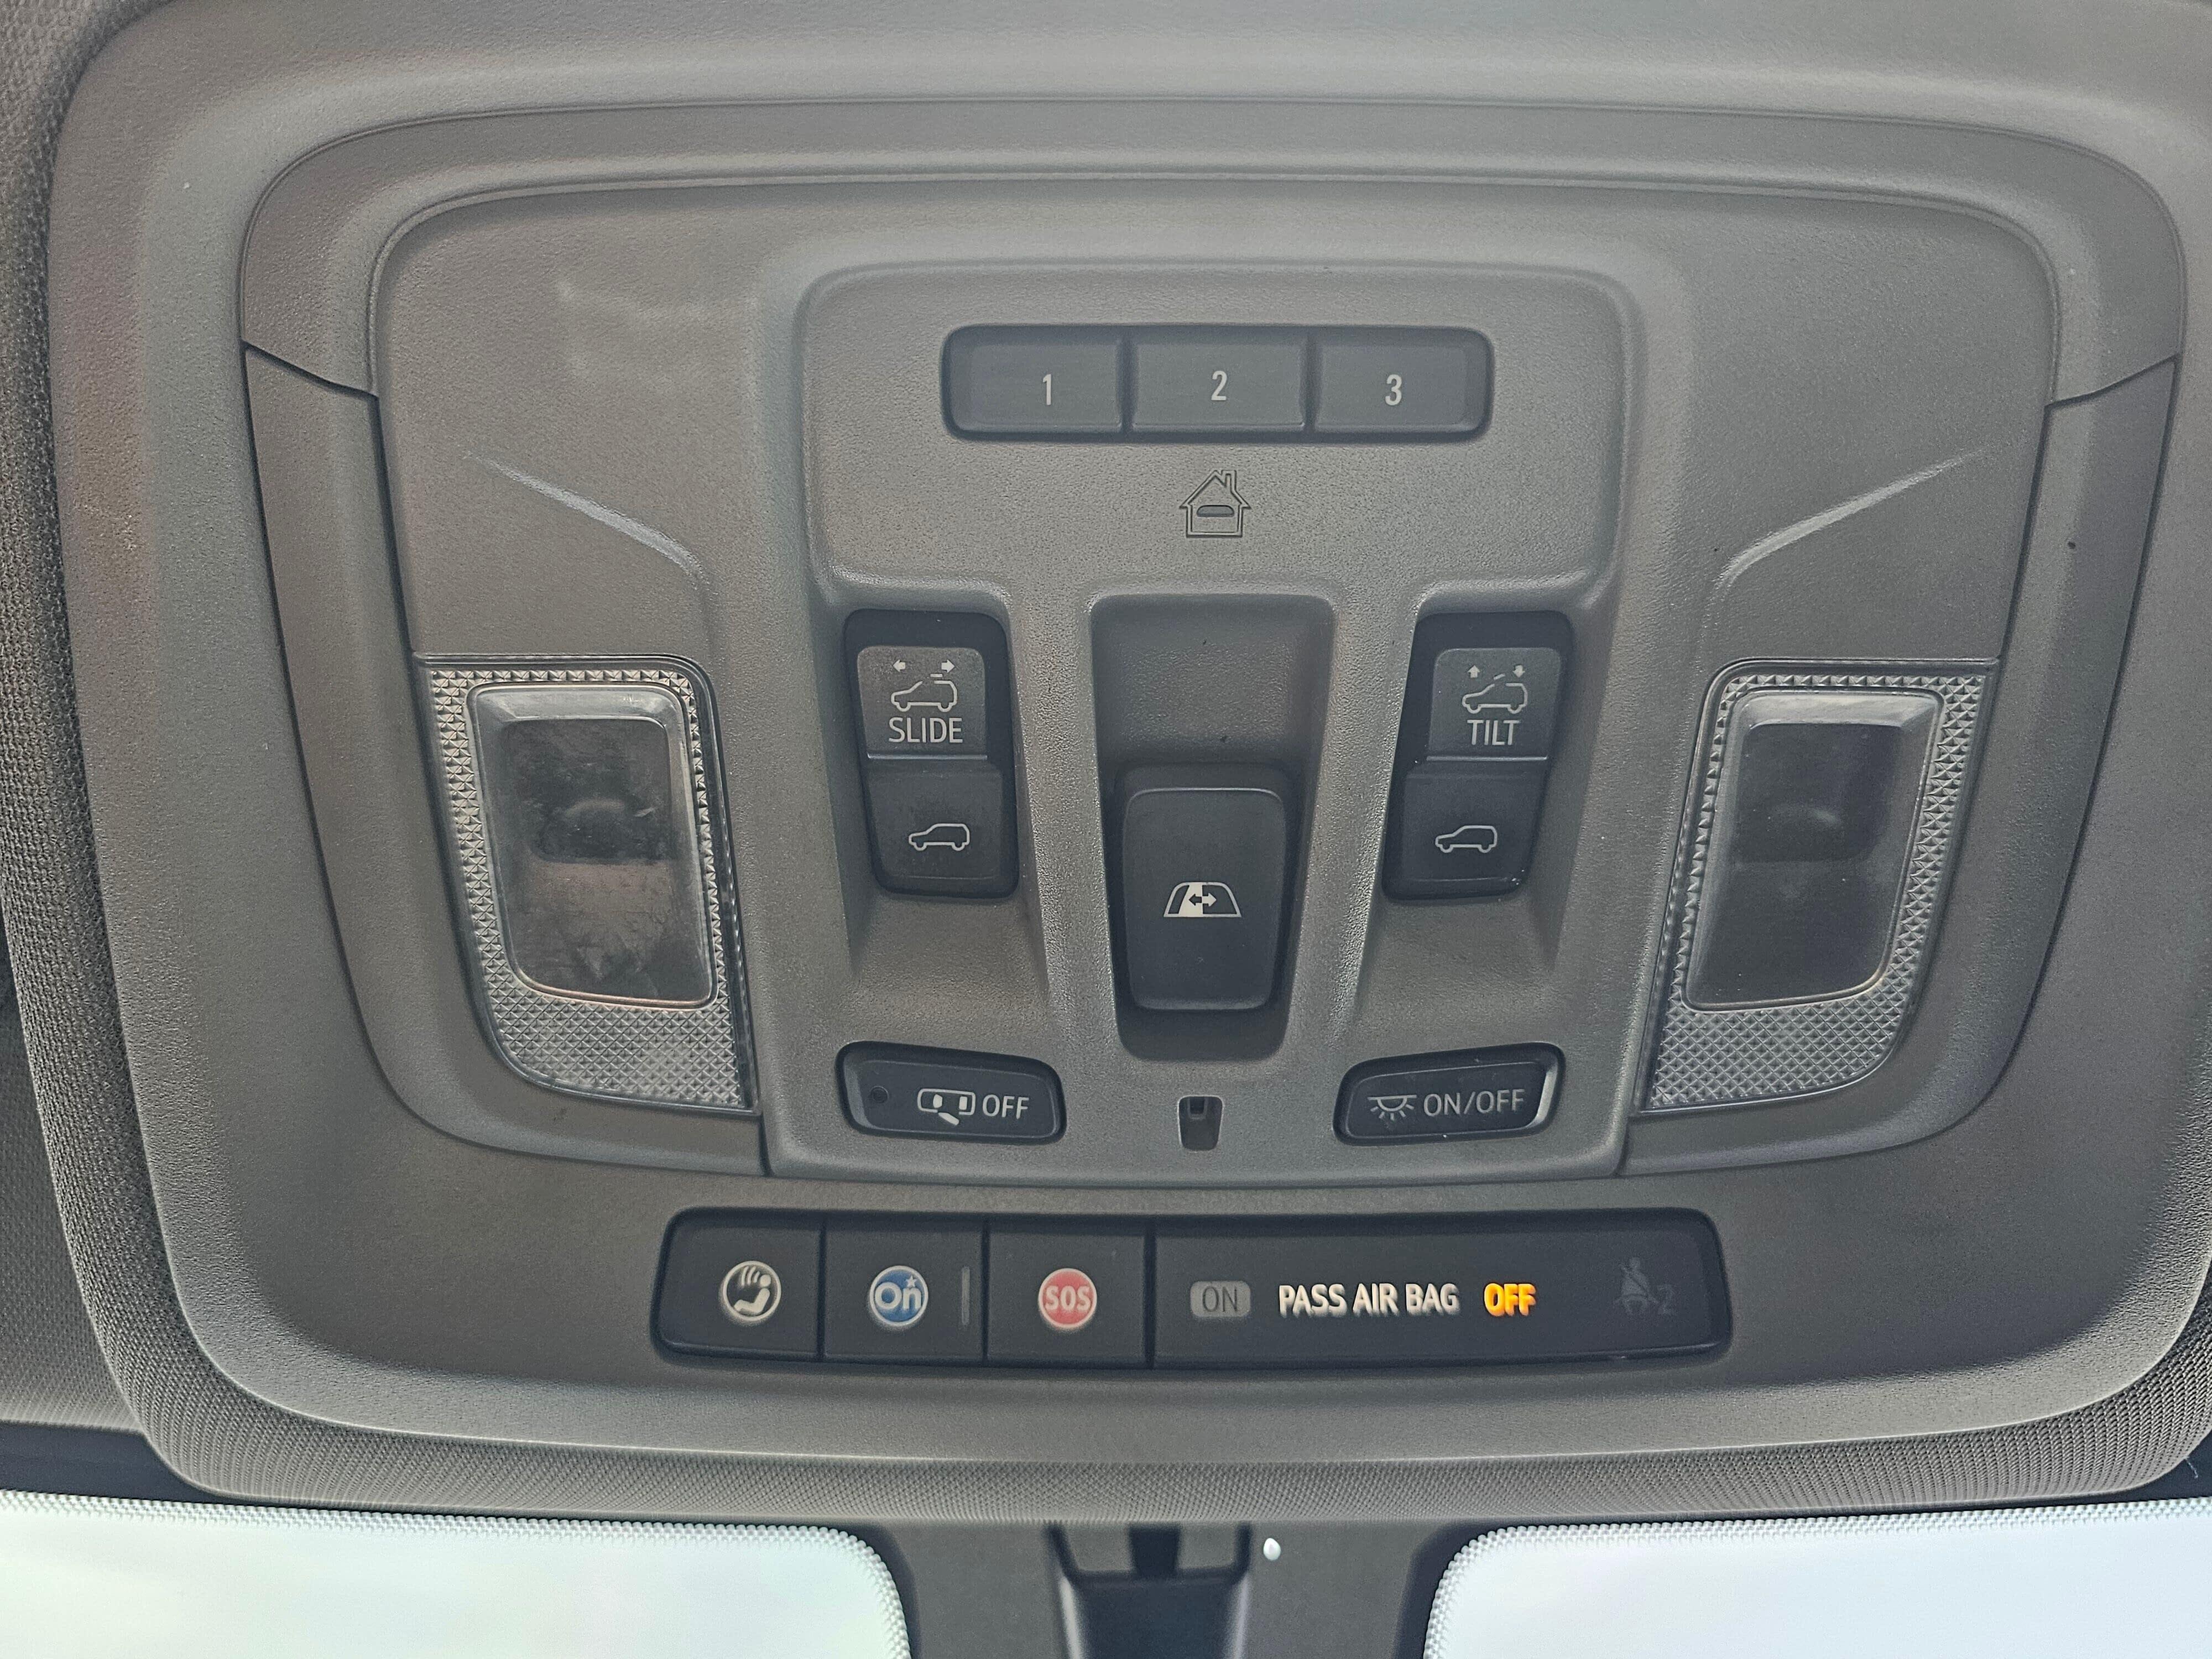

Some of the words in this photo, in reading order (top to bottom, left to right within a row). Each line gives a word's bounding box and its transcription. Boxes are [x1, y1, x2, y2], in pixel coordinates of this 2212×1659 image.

[1042, 374, 1052, 405] 1
[1211, 371, 1228, 401] 2
[1385, 374, 1402, 406] 3
[888, 717, 963, 743] SLIDE
[1467, 719, 1520, 745] TILT
[982, 1094, 1029, 1119] OFF
[1423, 1088, 1525, 1117] ON/OFF
[875, 1282, 922, 1311] On
[1045, 1285, 1091, 1311] SOS
[1202, 1286, 1238, 1313] ON
[1279, 1284, 1347, 1316] PASS
[1352, 1283, 1399, 1315] AIR
[1405, 1283, 1459, 1314] BAG
[1484, 1283, 1536, 1316] OFF
